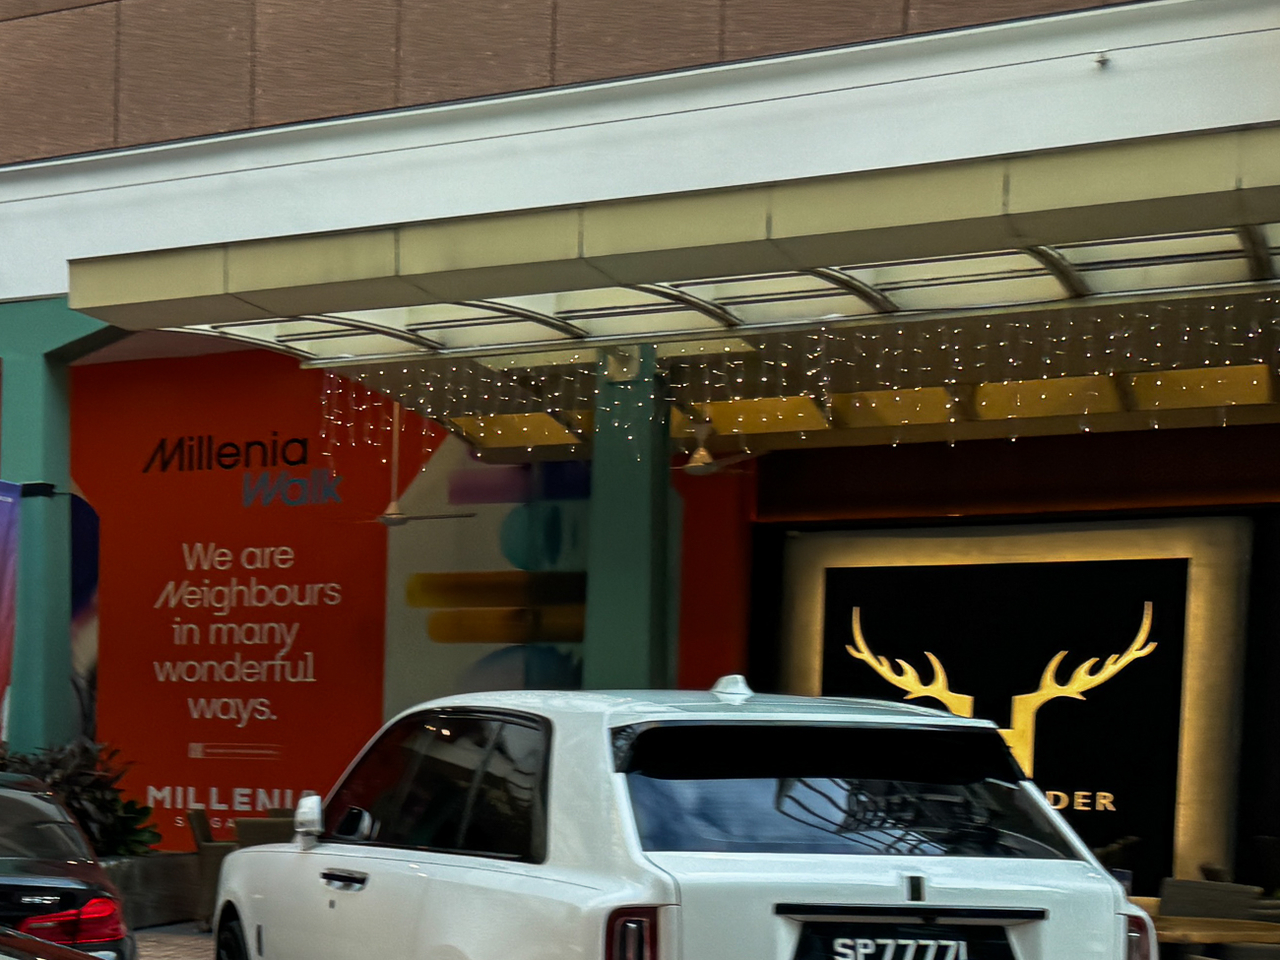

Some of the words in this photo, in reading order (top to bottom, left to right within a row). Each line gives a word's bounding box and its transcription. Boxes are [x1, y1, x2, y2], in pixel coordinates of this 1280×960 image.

[142, 431, 308, 473] Millenia
[241, 468, 343, 508] Walk
[182, 542, 233, 570] We
[240, 546, 295, 570] are
[153, 577, 342, 616] Neighbours
[172, 617, 200, 645] in
[209, 622, 300, 656] many
[153, 652, 317, 682] wonderful
[187, 697, 277, 728] ways.
